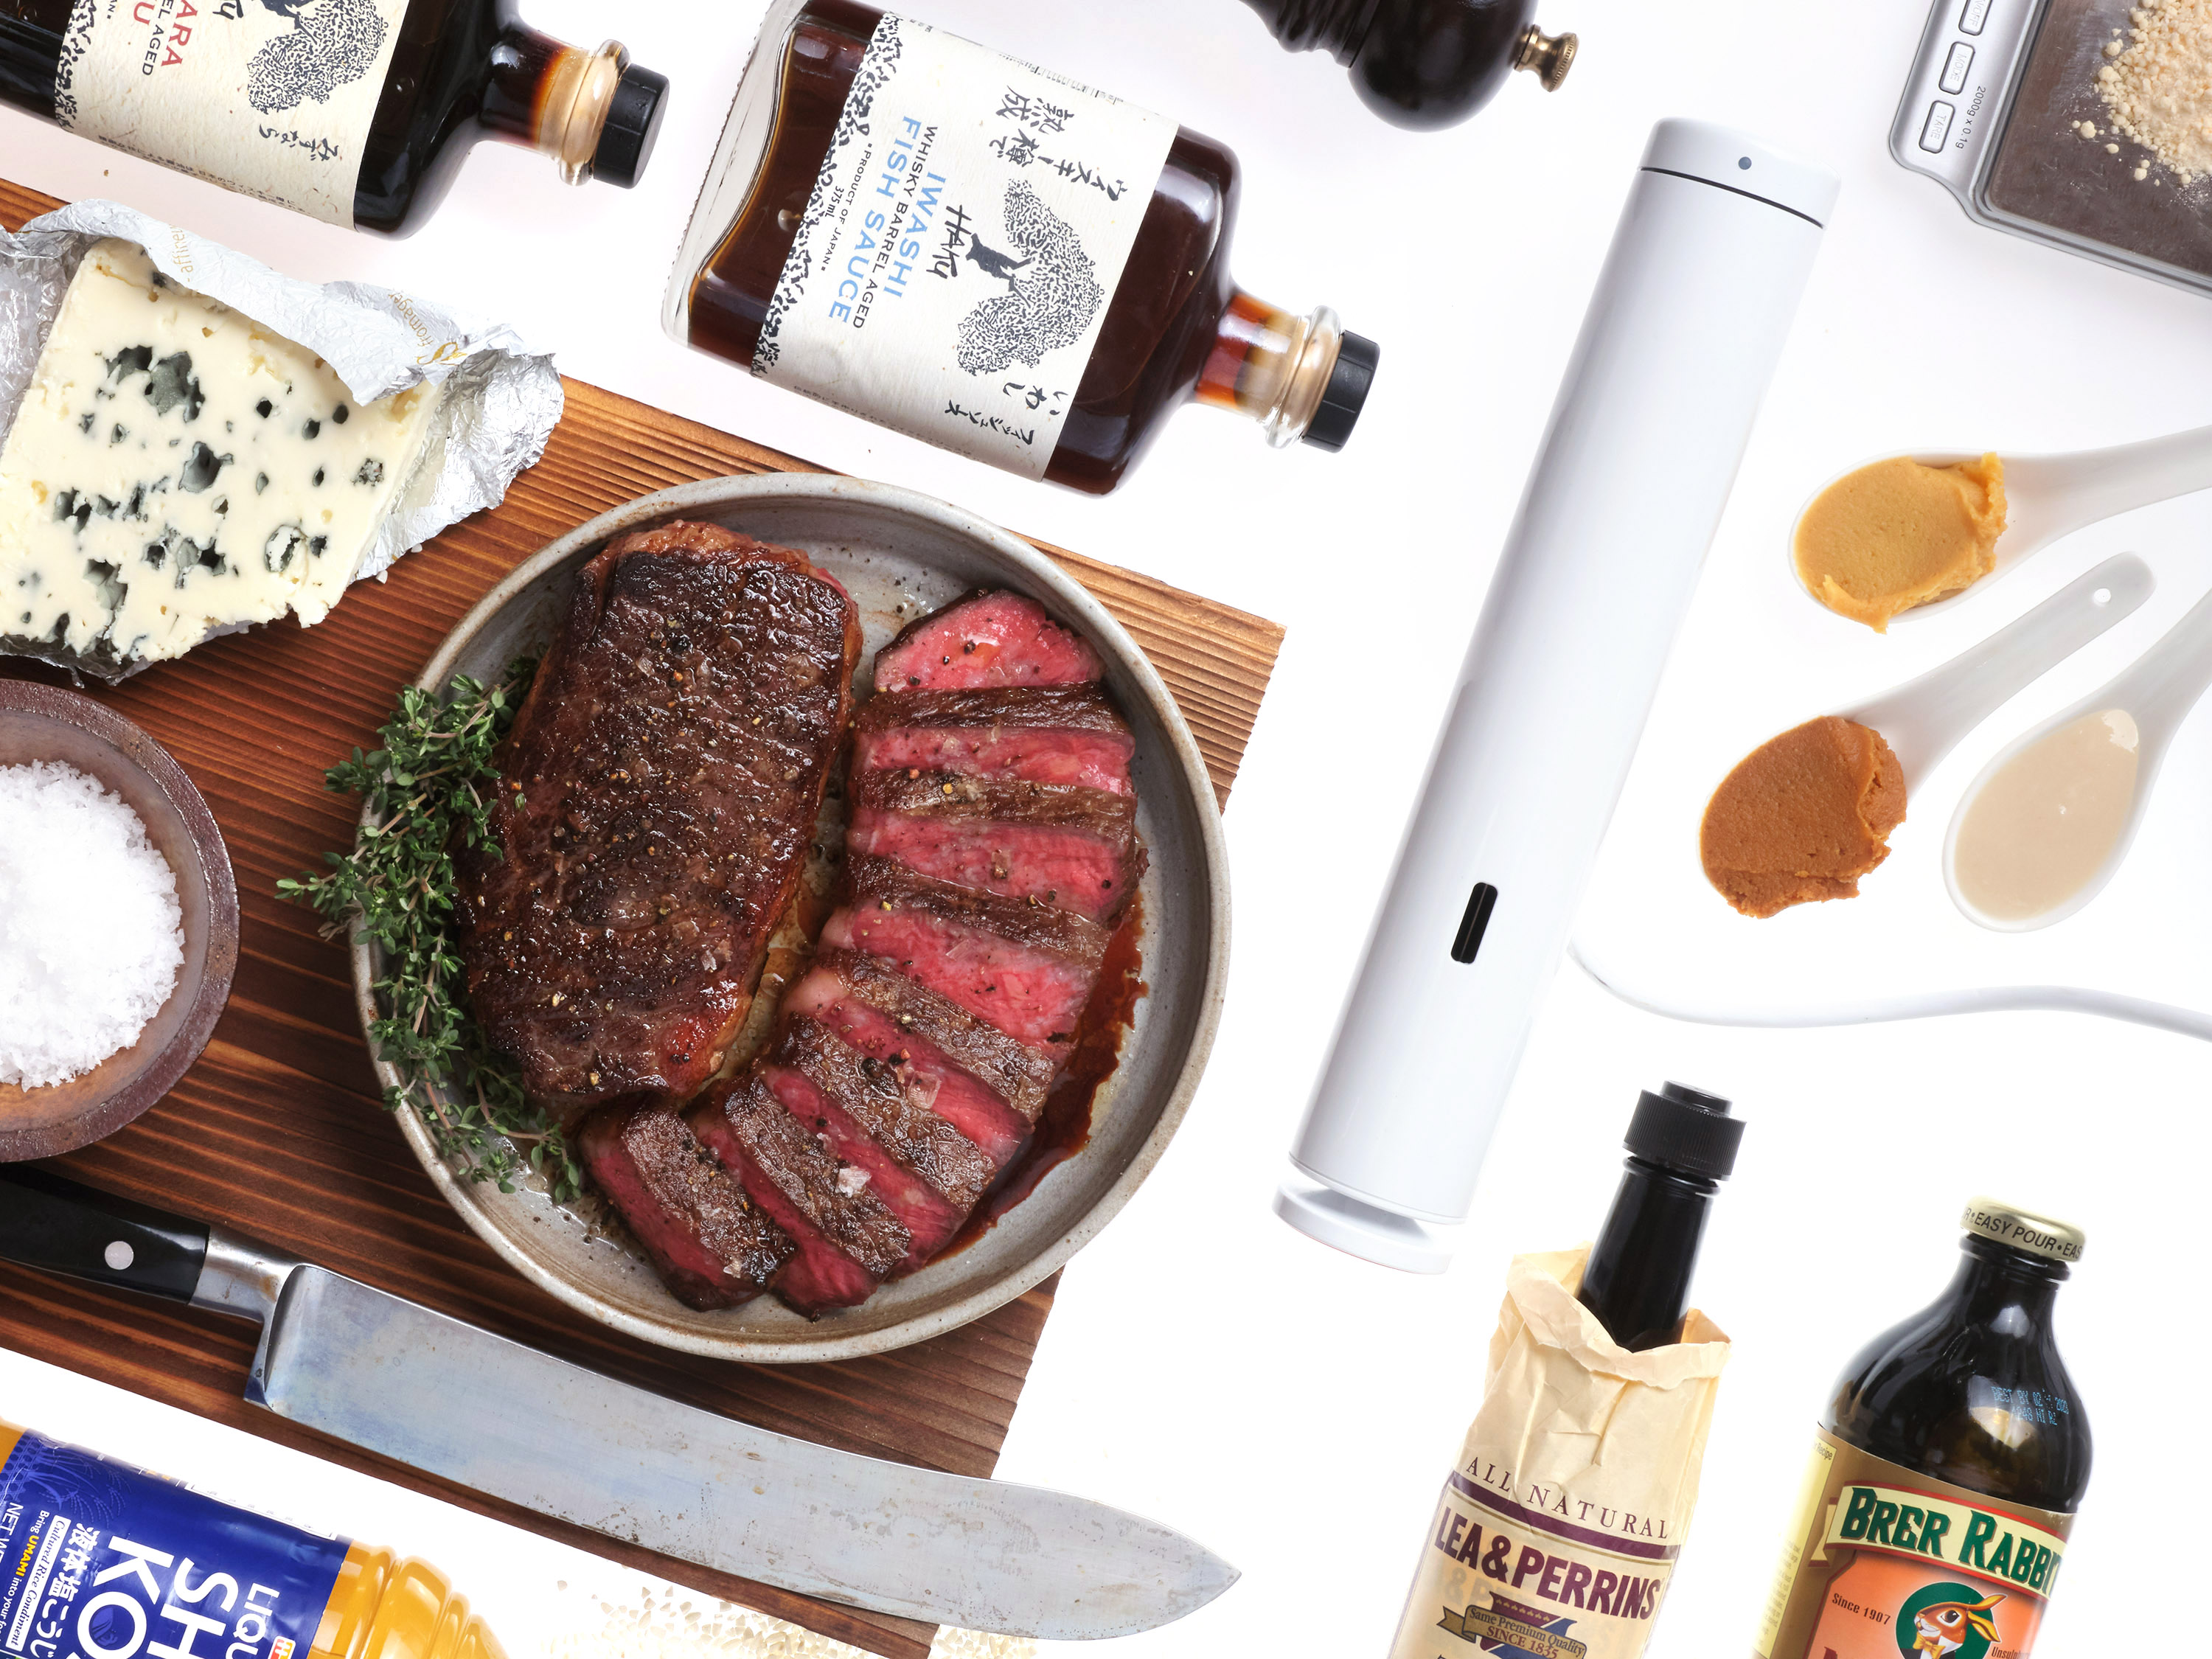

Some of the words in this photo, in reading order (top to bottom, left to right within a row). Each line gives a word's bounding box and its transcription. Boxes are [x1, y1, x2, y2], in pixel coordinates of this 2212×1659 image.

[142, 24, 164, 75] AGED
[1950, 53, 1967, 83] MODE
[1966, 86, 1986, 116] 2000g
[259, 123, 339, 161] みずなら
[1930, 115, 1947, 140] TARE
[1955, 128, 1972, 149] 0.1g
[876, 116, 922, 198] FISH
[903, 126, 939, 198] WHISKY
[831, 185, 844, 204] 375
[845, 150, 872, 206] PRODUCT
[824, 204, 836, 218] mL
[839, 209, 849, 224] OF
[822, 227, 841, 265] JAPAN
[872, 201, 909, 274] BARREL
[883, 171, 946, 298] IWASHI
[828, 209, 886, 323] SAUCE
[388, 292, 434, 347] fromager
[852, 278, 878, 329] AGED
[1003, 382, 1068, 414] いわし
[1975, 1212, 2011, 1234] EASY
[2012, 1226, 2057, 1251] POUR
[1991, 1386, 2012, 1403] BEST
[1817, 1441, 1833, 1461] Recipe
[1466, 1456, 1512, 1492] ALL
[1526, 1484, 1669, 1540] NATURAL
[1, 1502, 24, 1536] NET
[29, 1509, 50, 1534] Bring
[1840, 1486, 1951, 1559] BRER
[15, 1534, 40, 1577] UMAMI
[41, 1520, 66, 1566] Cultured
[8, 1576, 22, 1597] into
[29, 1523, 100, 1658] 液体塩こうじ
[31, 1564, 48, 1587] Rice
[0, 1596, 13, 1620] your
[10, 1589, 38, 1646] Condiment
[1832, 1593, 1860, 1613] Since
[1863, 1607, 1891, 1625] 1907
[1469, 1607, 1492, 1625] Same
[1495, 1615, 1546, 1641] Premium
[1548, 1632, 1586, 1658] Quality
[1486, 1626, 1526, 1648] SINCE
[1528, 1640, 1558, 1659] 1835
